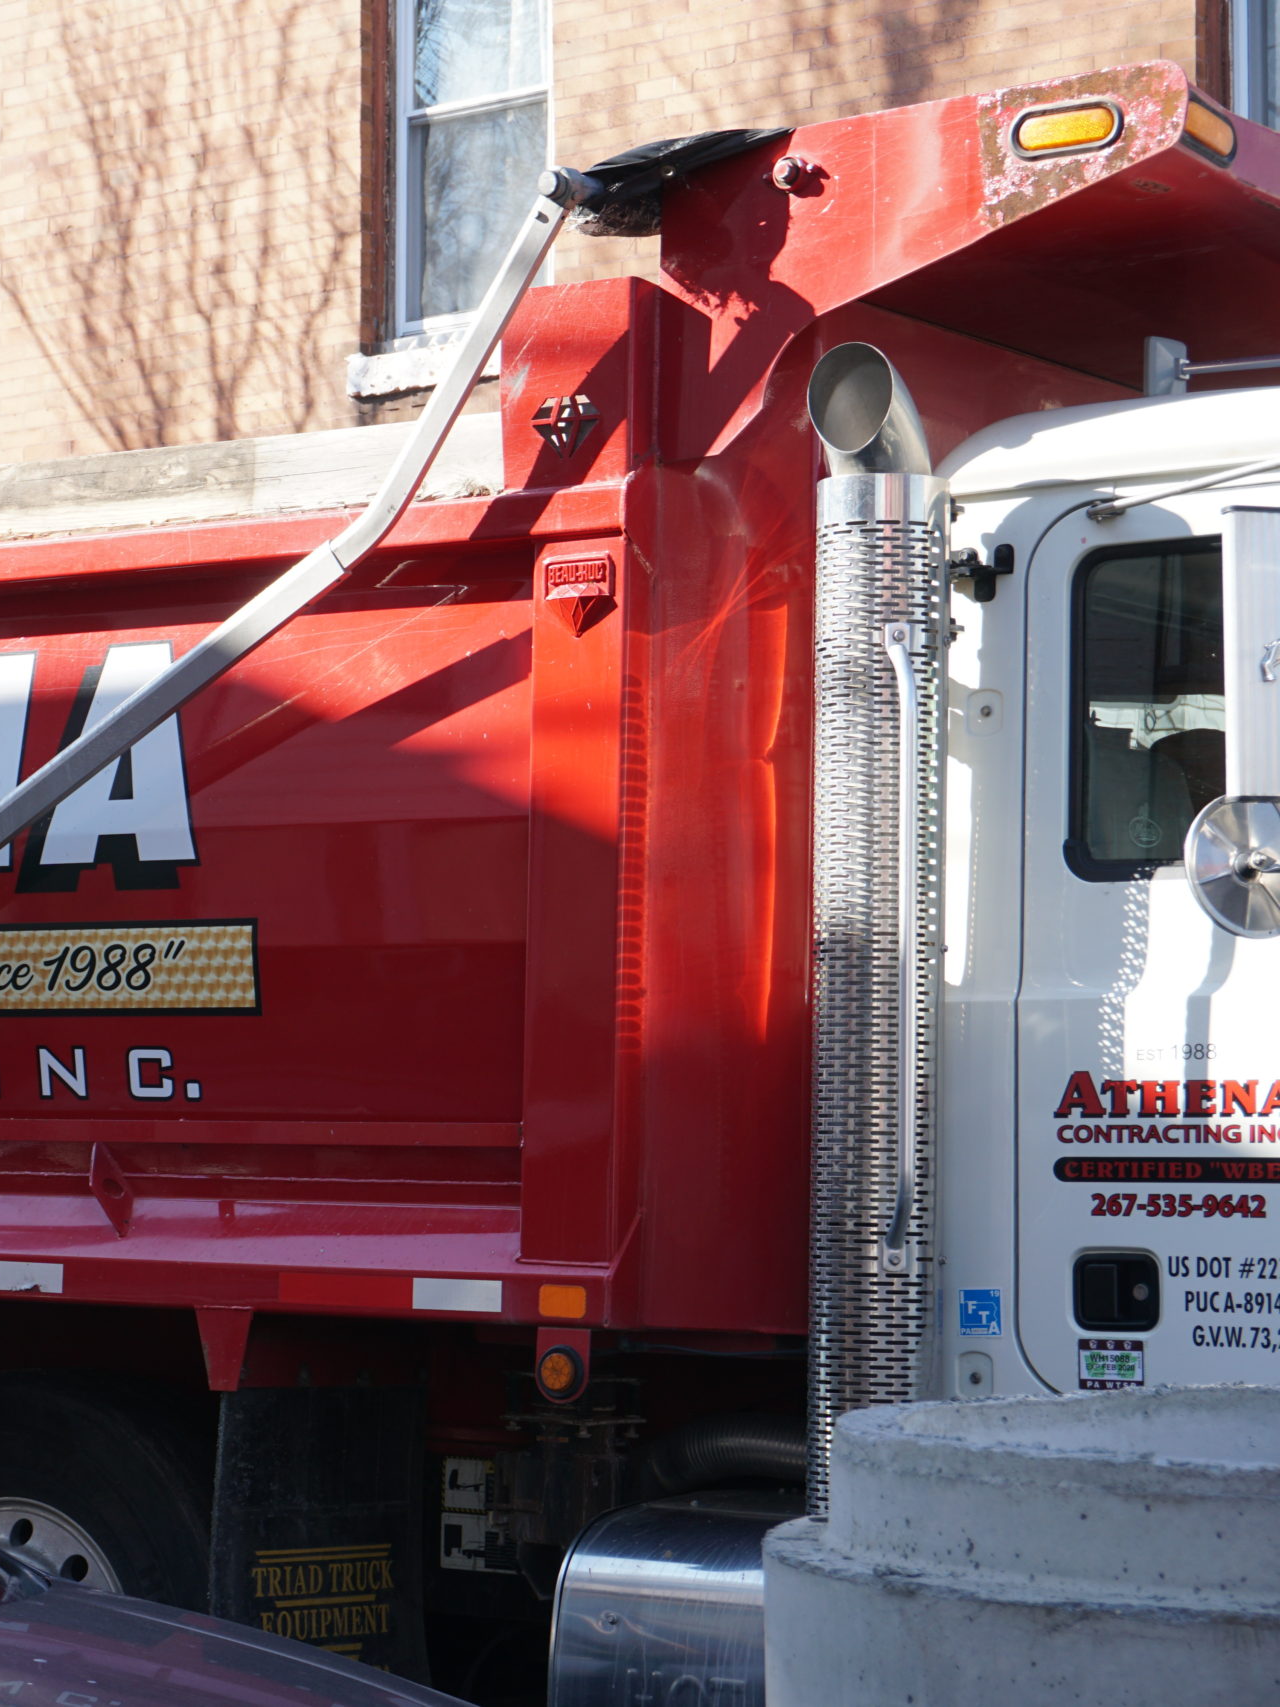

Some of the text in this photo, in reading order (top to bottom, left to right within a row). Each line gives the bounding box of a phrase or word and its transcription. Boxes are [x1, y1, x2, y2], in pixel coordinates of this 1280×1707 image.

[42, 939, 186, 992] 1988"
[1169, 1042, 1217, 1061] 1988
[1056, 1124, 1242, 1144] CONTRACTING
[1064, 1161, 1203, 1180] CERTIFIED
[1090, 1192, 1267, 1219] 267-535-9642
[1168, 1255, 1190, 1278] US
[1196, 1256, 1232, 1279] DOT
[1184, 1290, 1220, 1313] PUC
[1192, 1324, 1247, 1349] G.V.W.
[1086, 1381, 1100, 1389] PA
[250, 1559, 395, 1599] TRIAD TRUCK
[259, 1603, 390, 1641] EQUIPMENT
